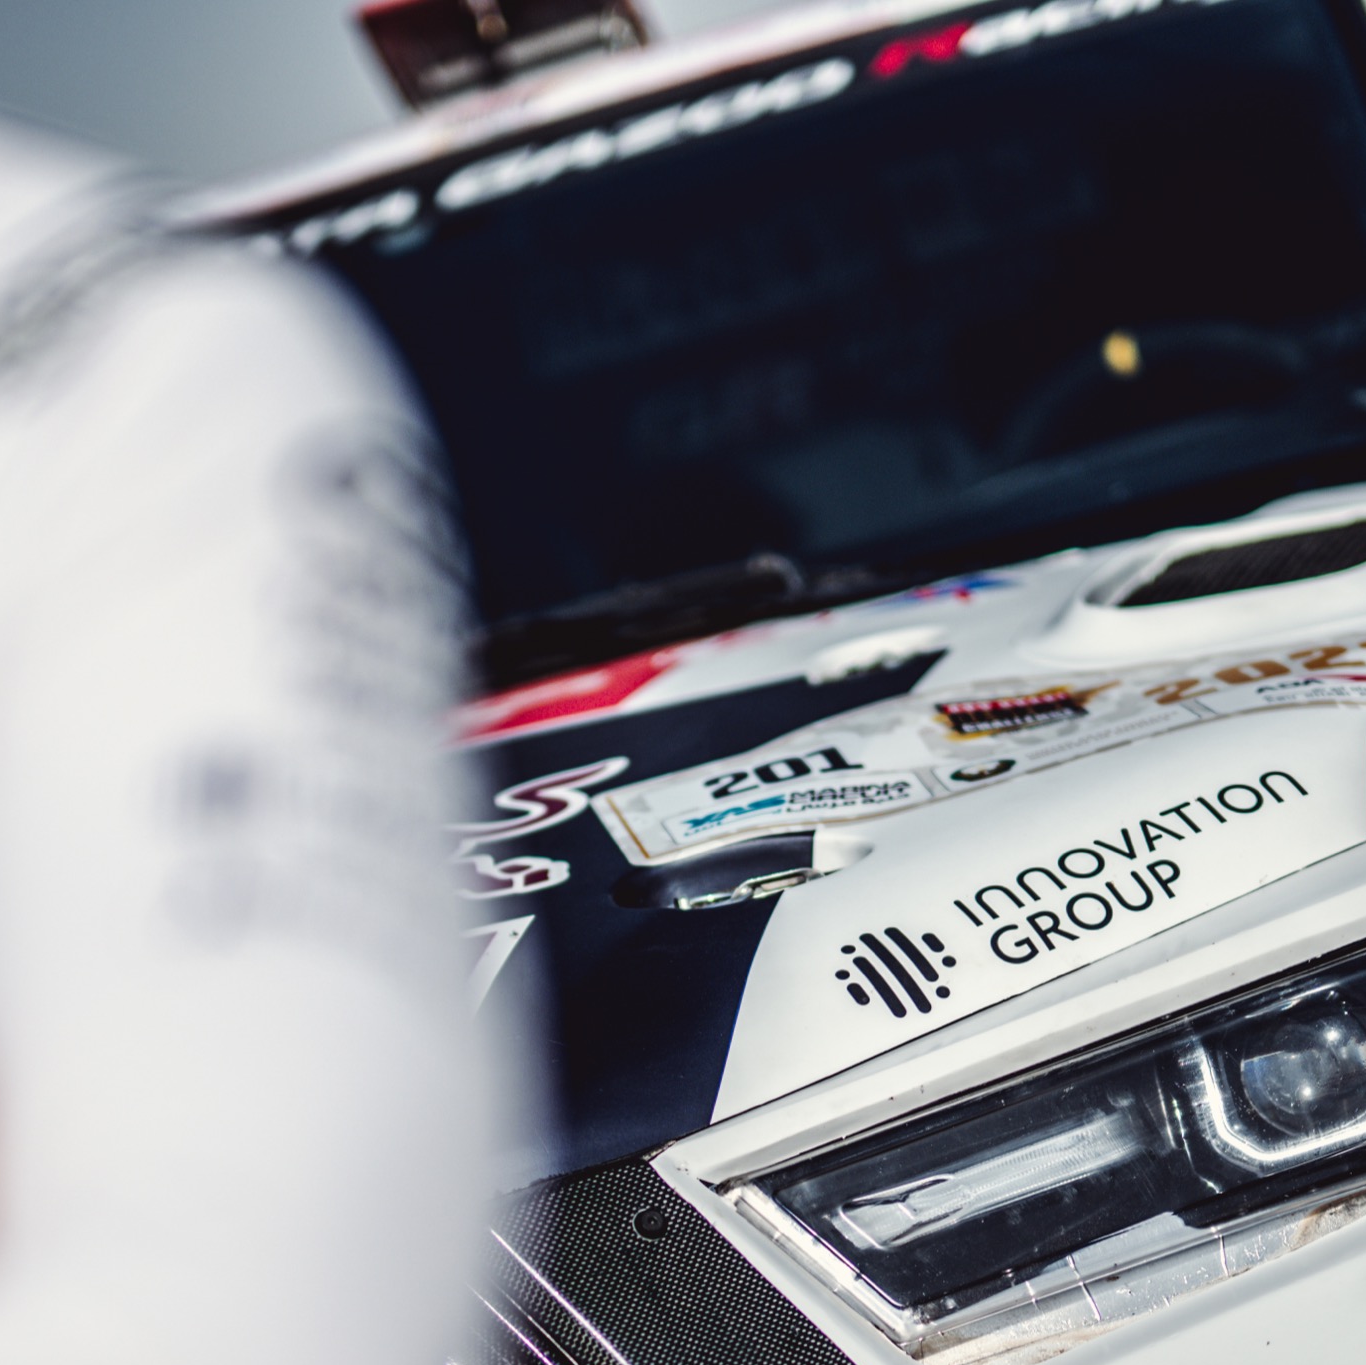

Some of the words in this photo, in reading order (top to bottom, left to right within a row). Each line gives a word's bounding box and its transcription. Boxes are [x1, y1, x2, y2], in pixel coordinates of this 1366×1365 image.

[704, 747, 863, 799] 201
[953, 770, 1309, 927] INNOVATION
[990, 859, 1182, 965] GROUP
